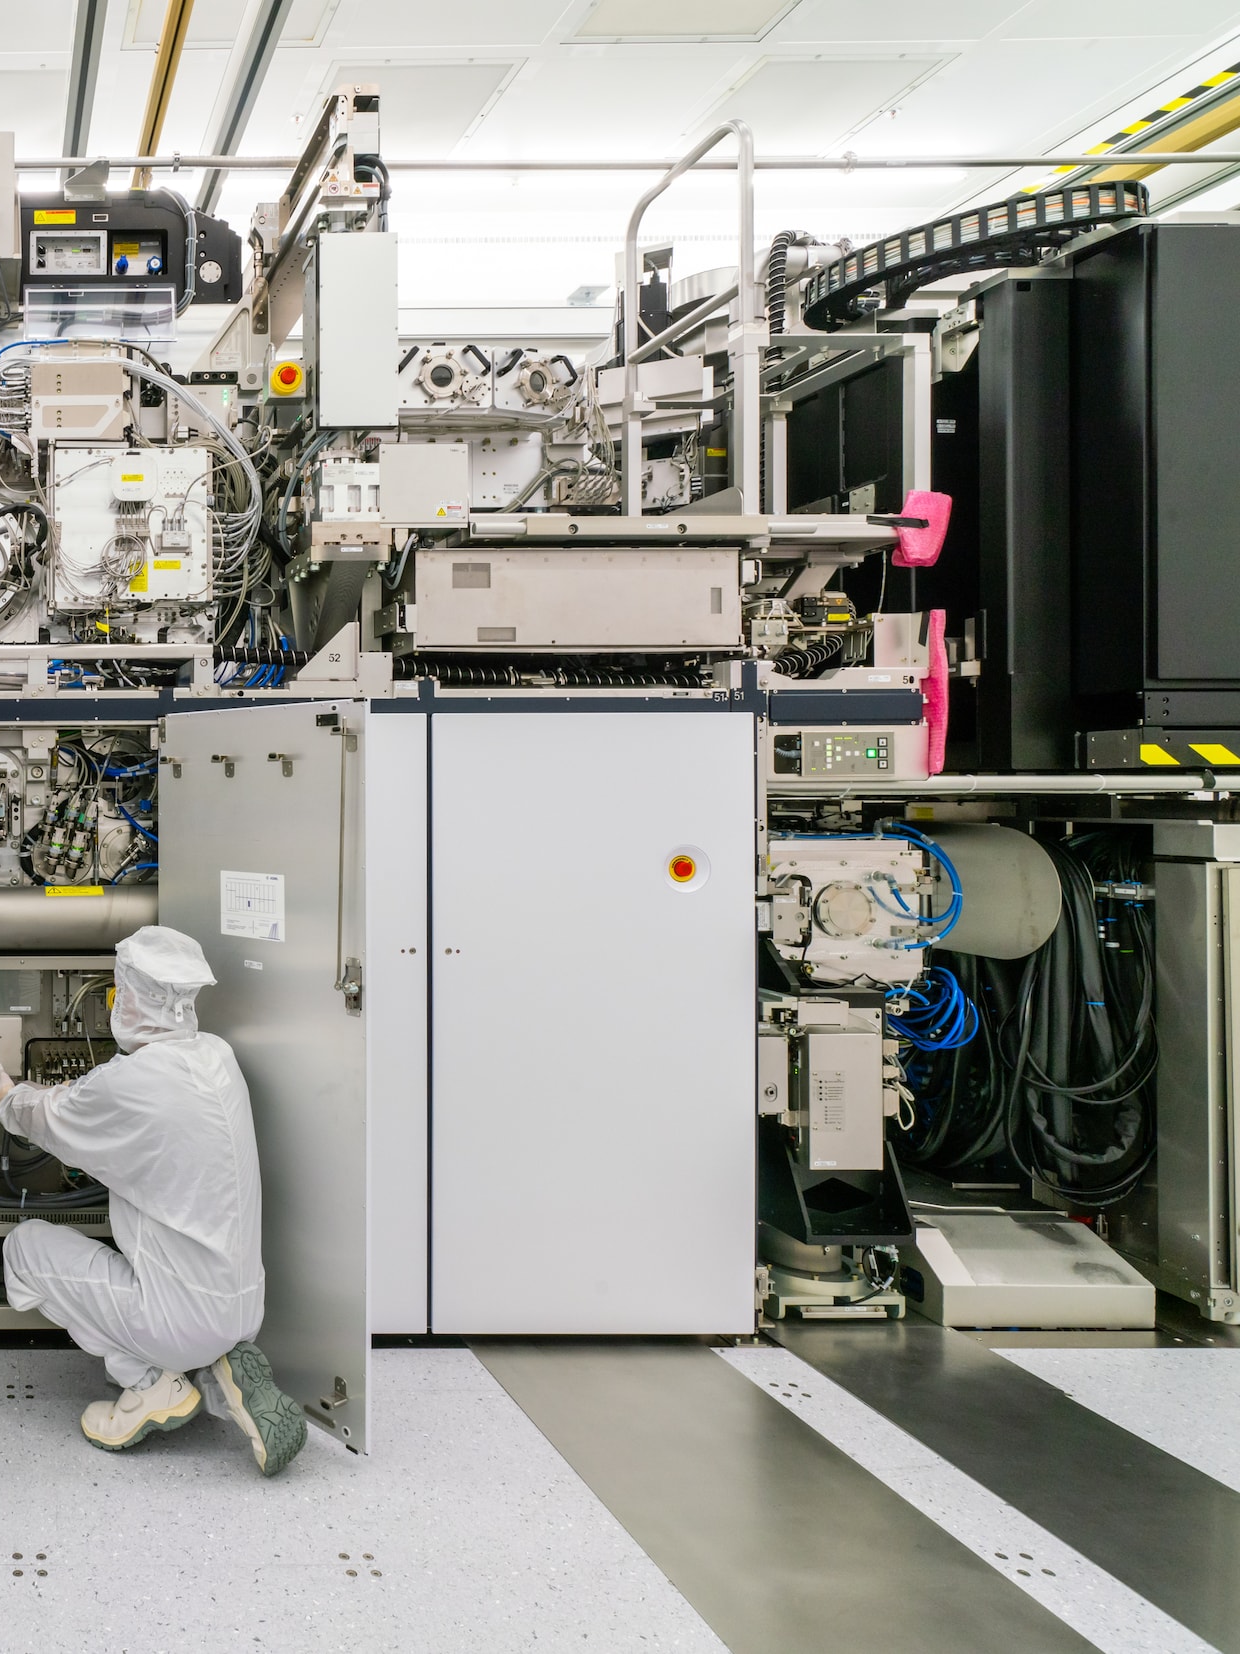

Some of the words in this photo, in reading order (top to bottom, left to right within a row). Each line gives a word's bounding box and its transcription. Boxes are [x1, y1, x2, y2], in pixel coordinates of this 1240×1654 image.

[328, 653, 341, 663] 52
[714, 692, 725, 702] 51
[734, 691, 745, 701] 51
